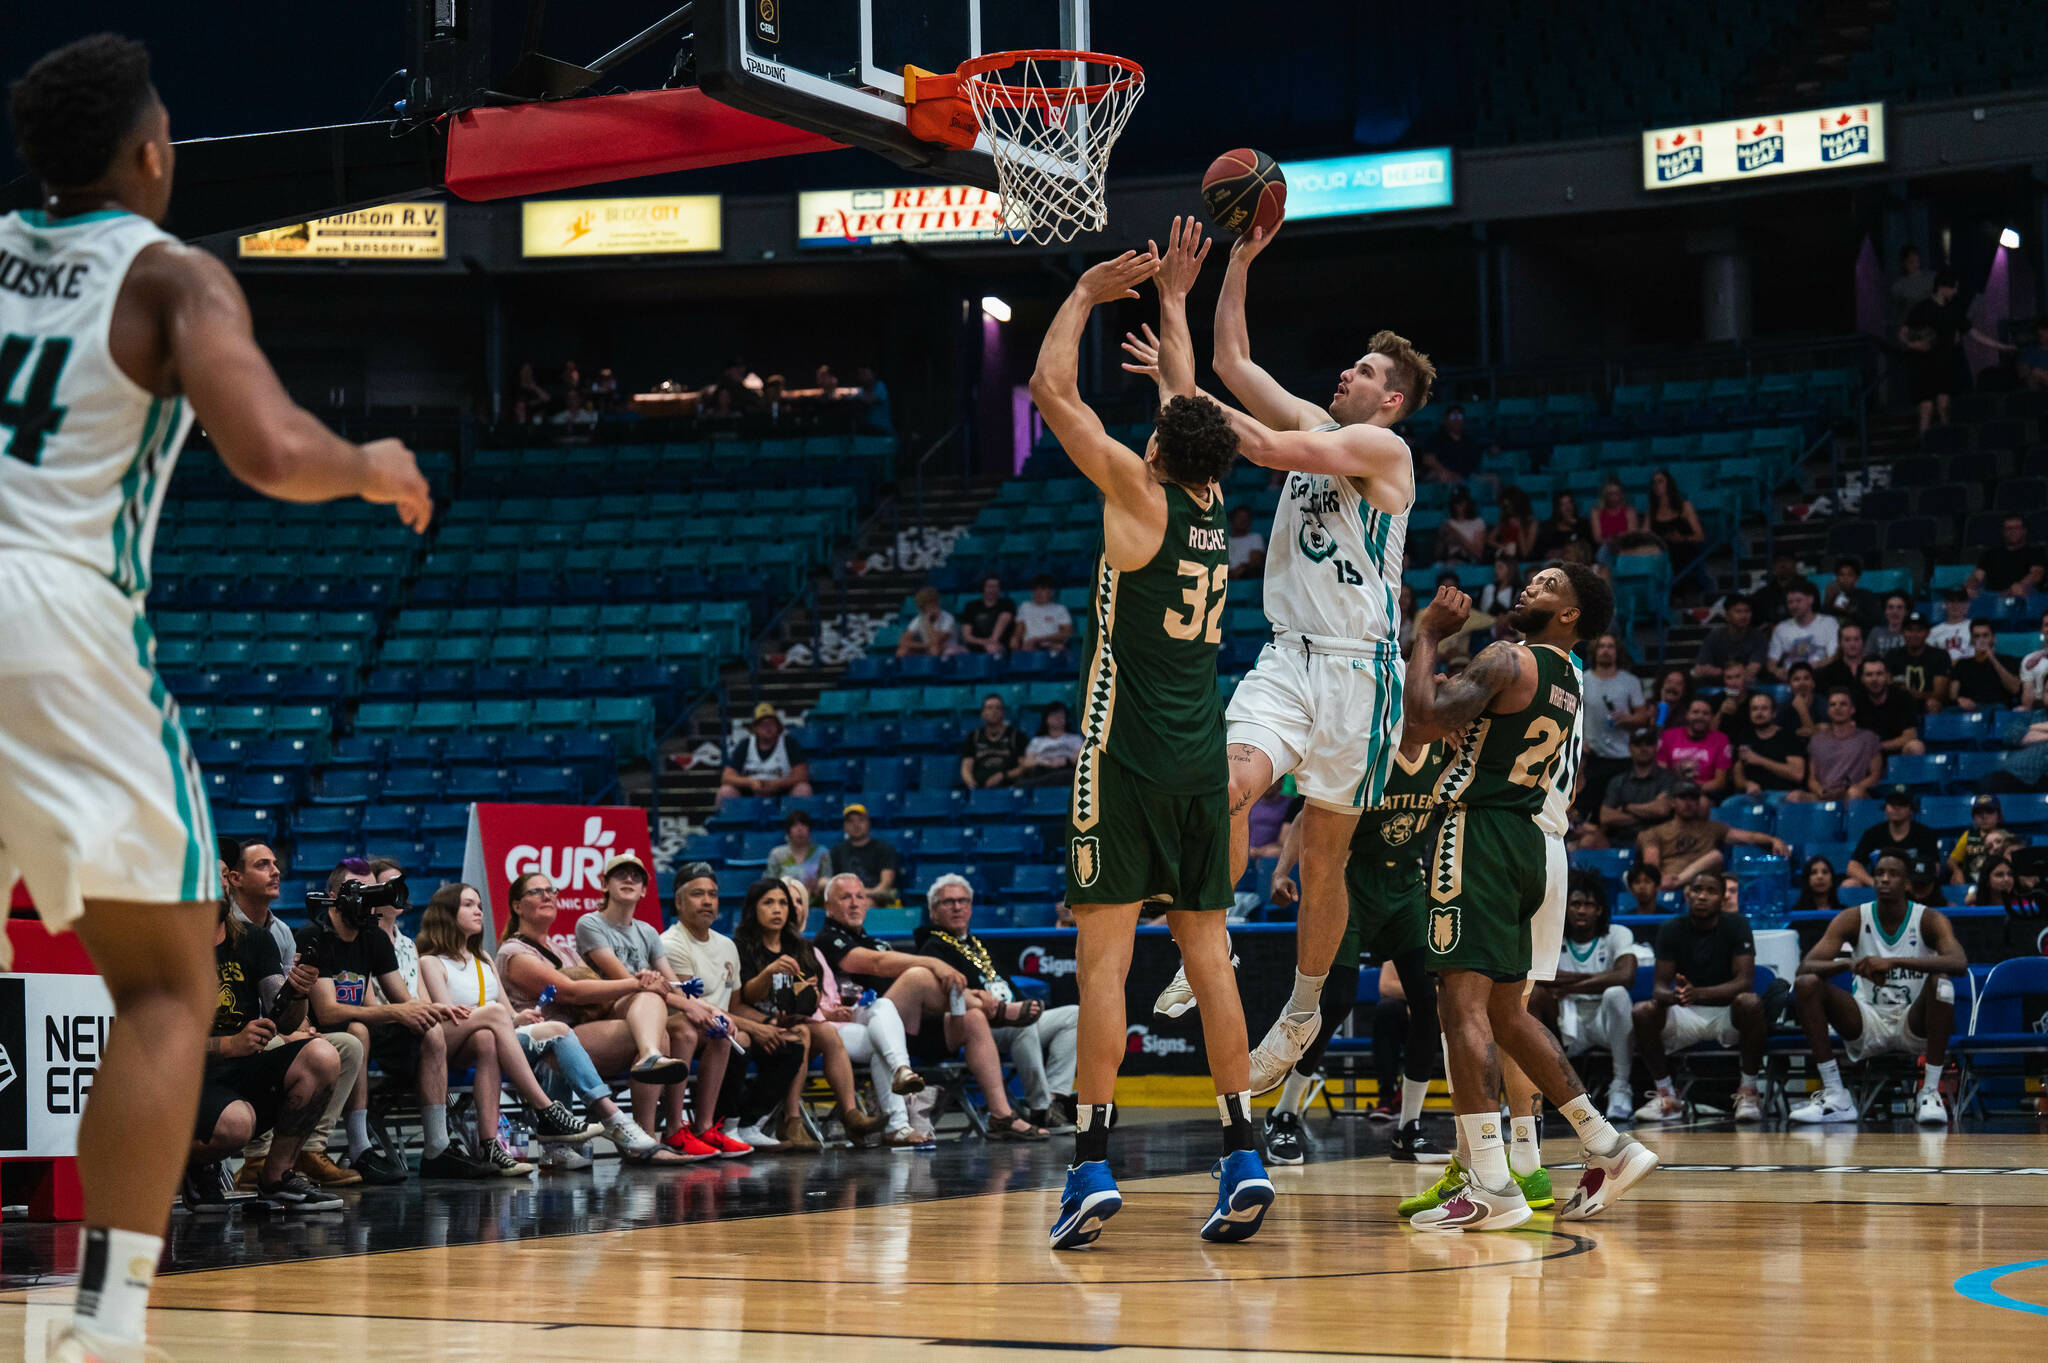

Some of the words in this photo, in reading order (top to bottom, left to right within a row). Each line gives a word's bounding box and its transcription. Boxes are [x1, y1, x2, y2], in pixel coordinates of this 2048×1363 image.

[760, 22, 775, 34] CEBL
[746, 57, 786, 83] SPALDING
[1738, 137, 1782, 158] MAPLE
[1822, 127, 1866, 149] MAPLE
[1658, 147, 1702, 168] MAPLE
[1745, 150, 1776, 169] LEAF
[1829, 141, 1861, 159] LEAF
[1665, 160, 1696, 178] LEAF
[1293, 171, 1348, 192] YOUR
[1352, 168, 1381, 187] AD
[893, 187, 989, 208] REALT
[403, 208, 440, 225] R.V.
[1189, 525, 1227, 550] ROCHE
[1333, 560, 1364, 586] 15
[1163, 559, 1229, 644] 32
[1142, 1034, 1187, 1057] Signs
[46, 1066, 99, 1114] ER
